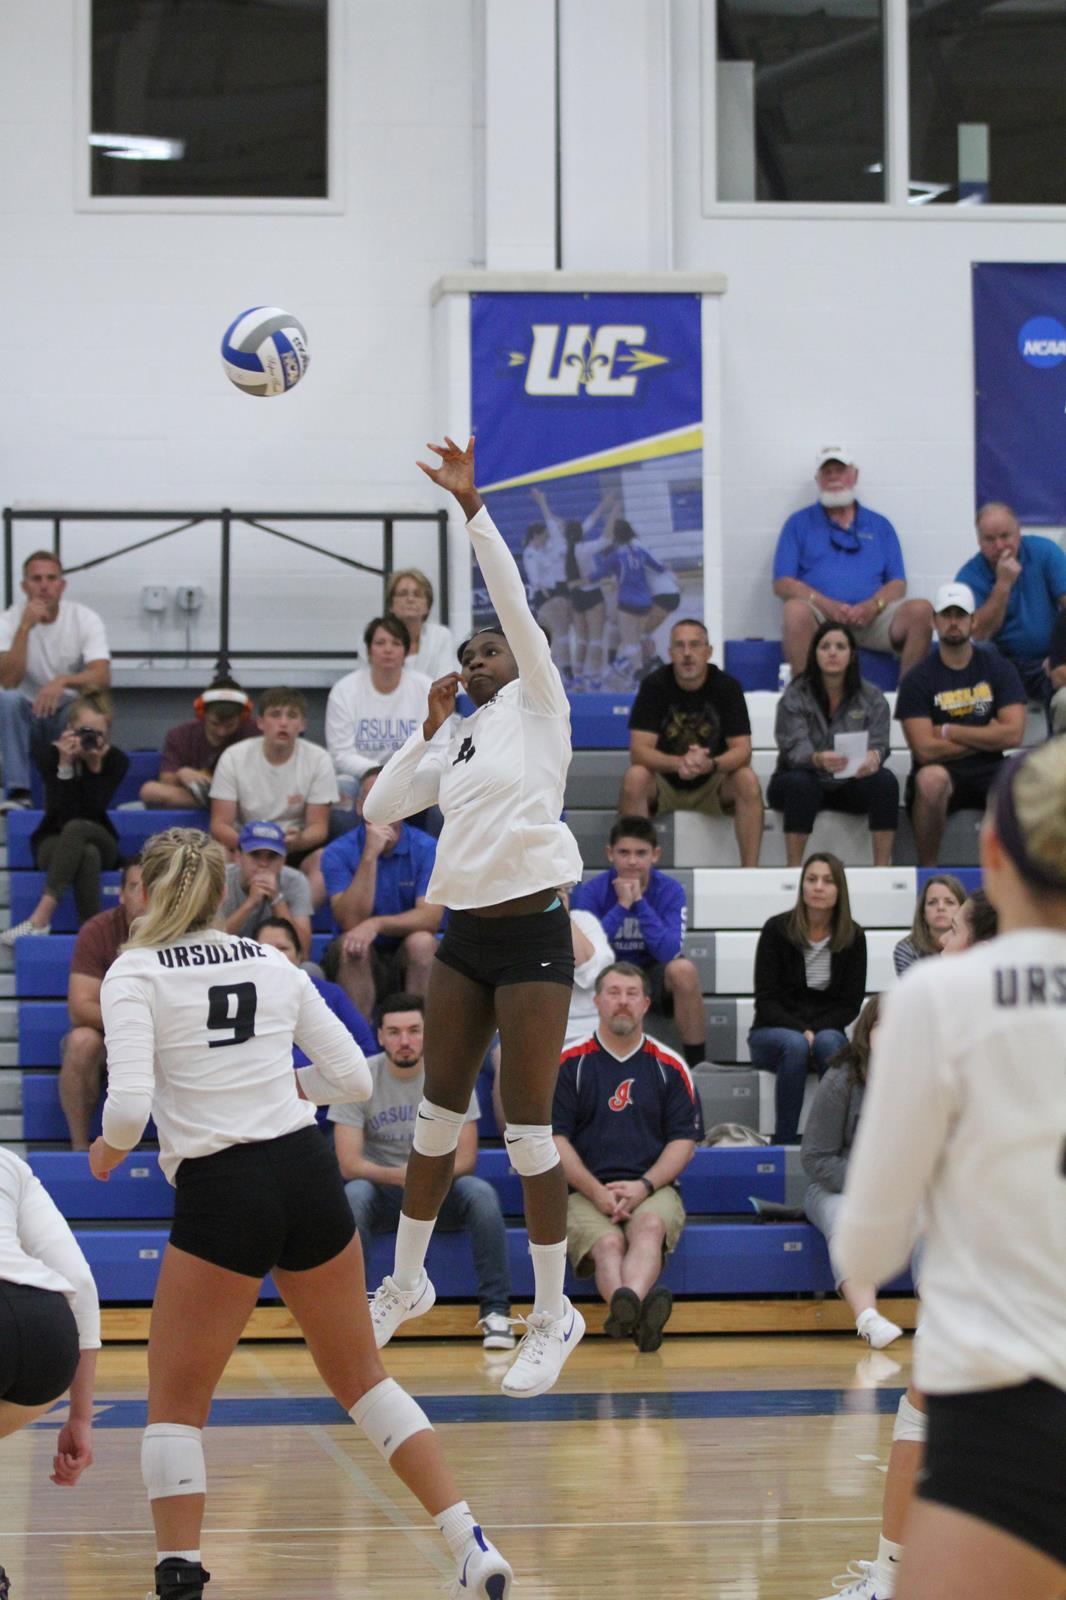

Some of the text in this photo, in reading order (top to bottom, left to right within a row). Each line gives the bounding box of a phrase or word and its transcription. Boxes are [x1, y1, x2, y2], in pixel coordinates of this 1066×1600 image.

[525, 324, 647, 396] UC
[1023, 339, 1066, 356] NCAA
[356, 718, 417, 738] RSULINE
[156, 940, 267, 968] URSULINE
[206, 981, 258, 1049] 9
